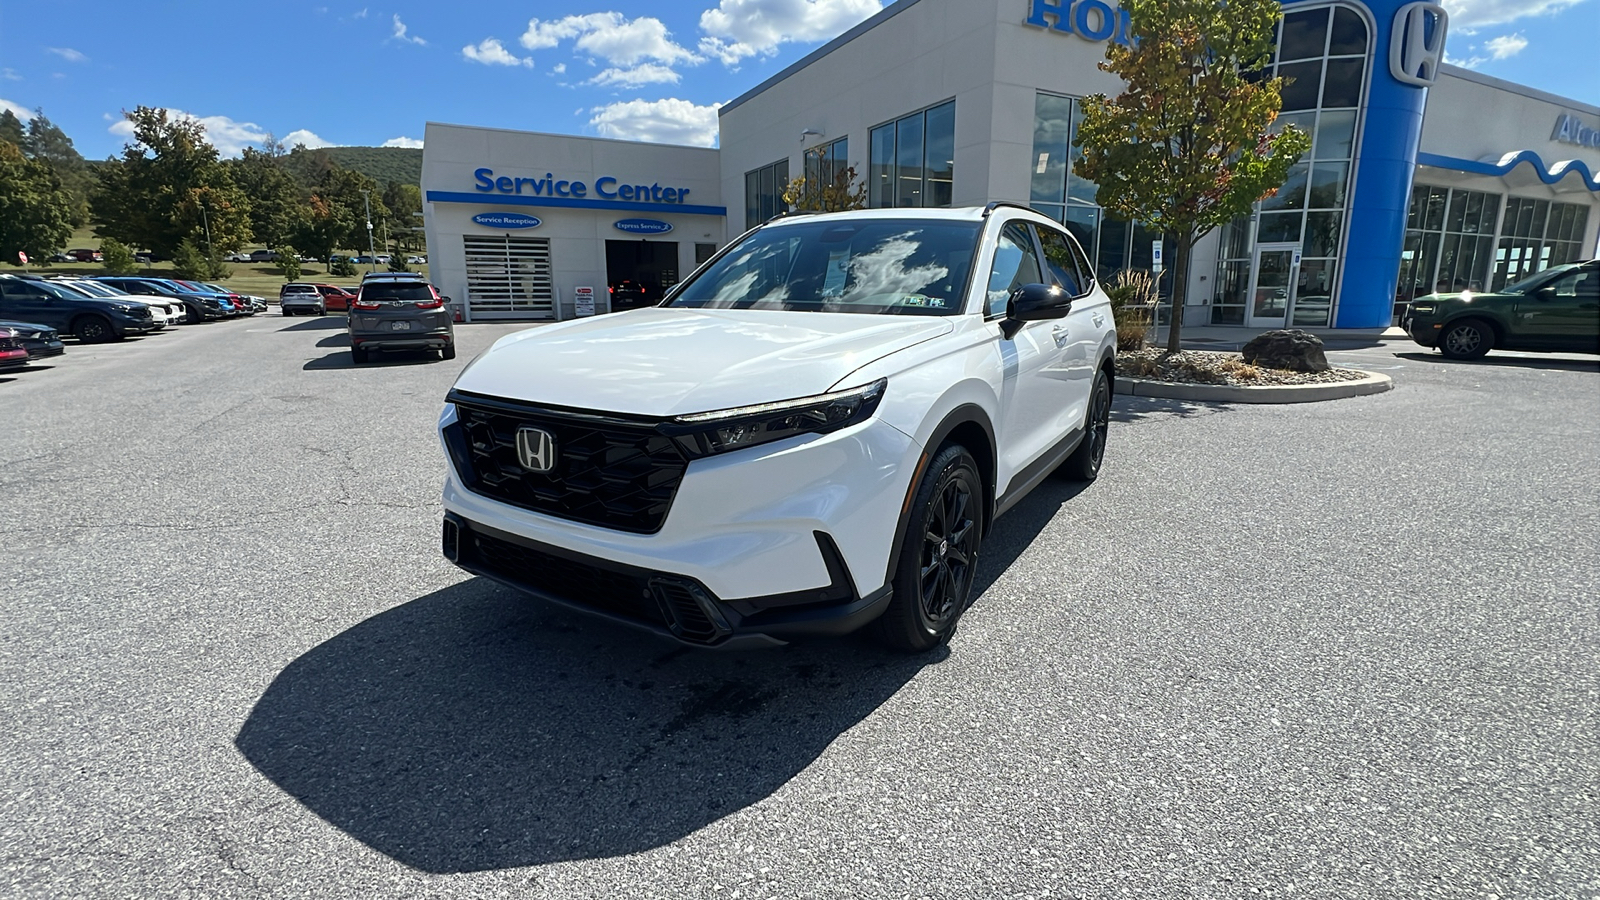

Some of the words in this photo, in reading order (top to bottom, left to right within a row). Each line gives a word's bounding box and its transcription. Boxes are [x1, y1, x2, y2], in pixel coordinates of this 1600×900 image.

[474, 168, 587, 197] Service
[595, 177, 690, 204] Center
[476, 215, 502, 223] Service
[503, 217, 537, 225] Reception
[617, 222, 639, 230] Express
